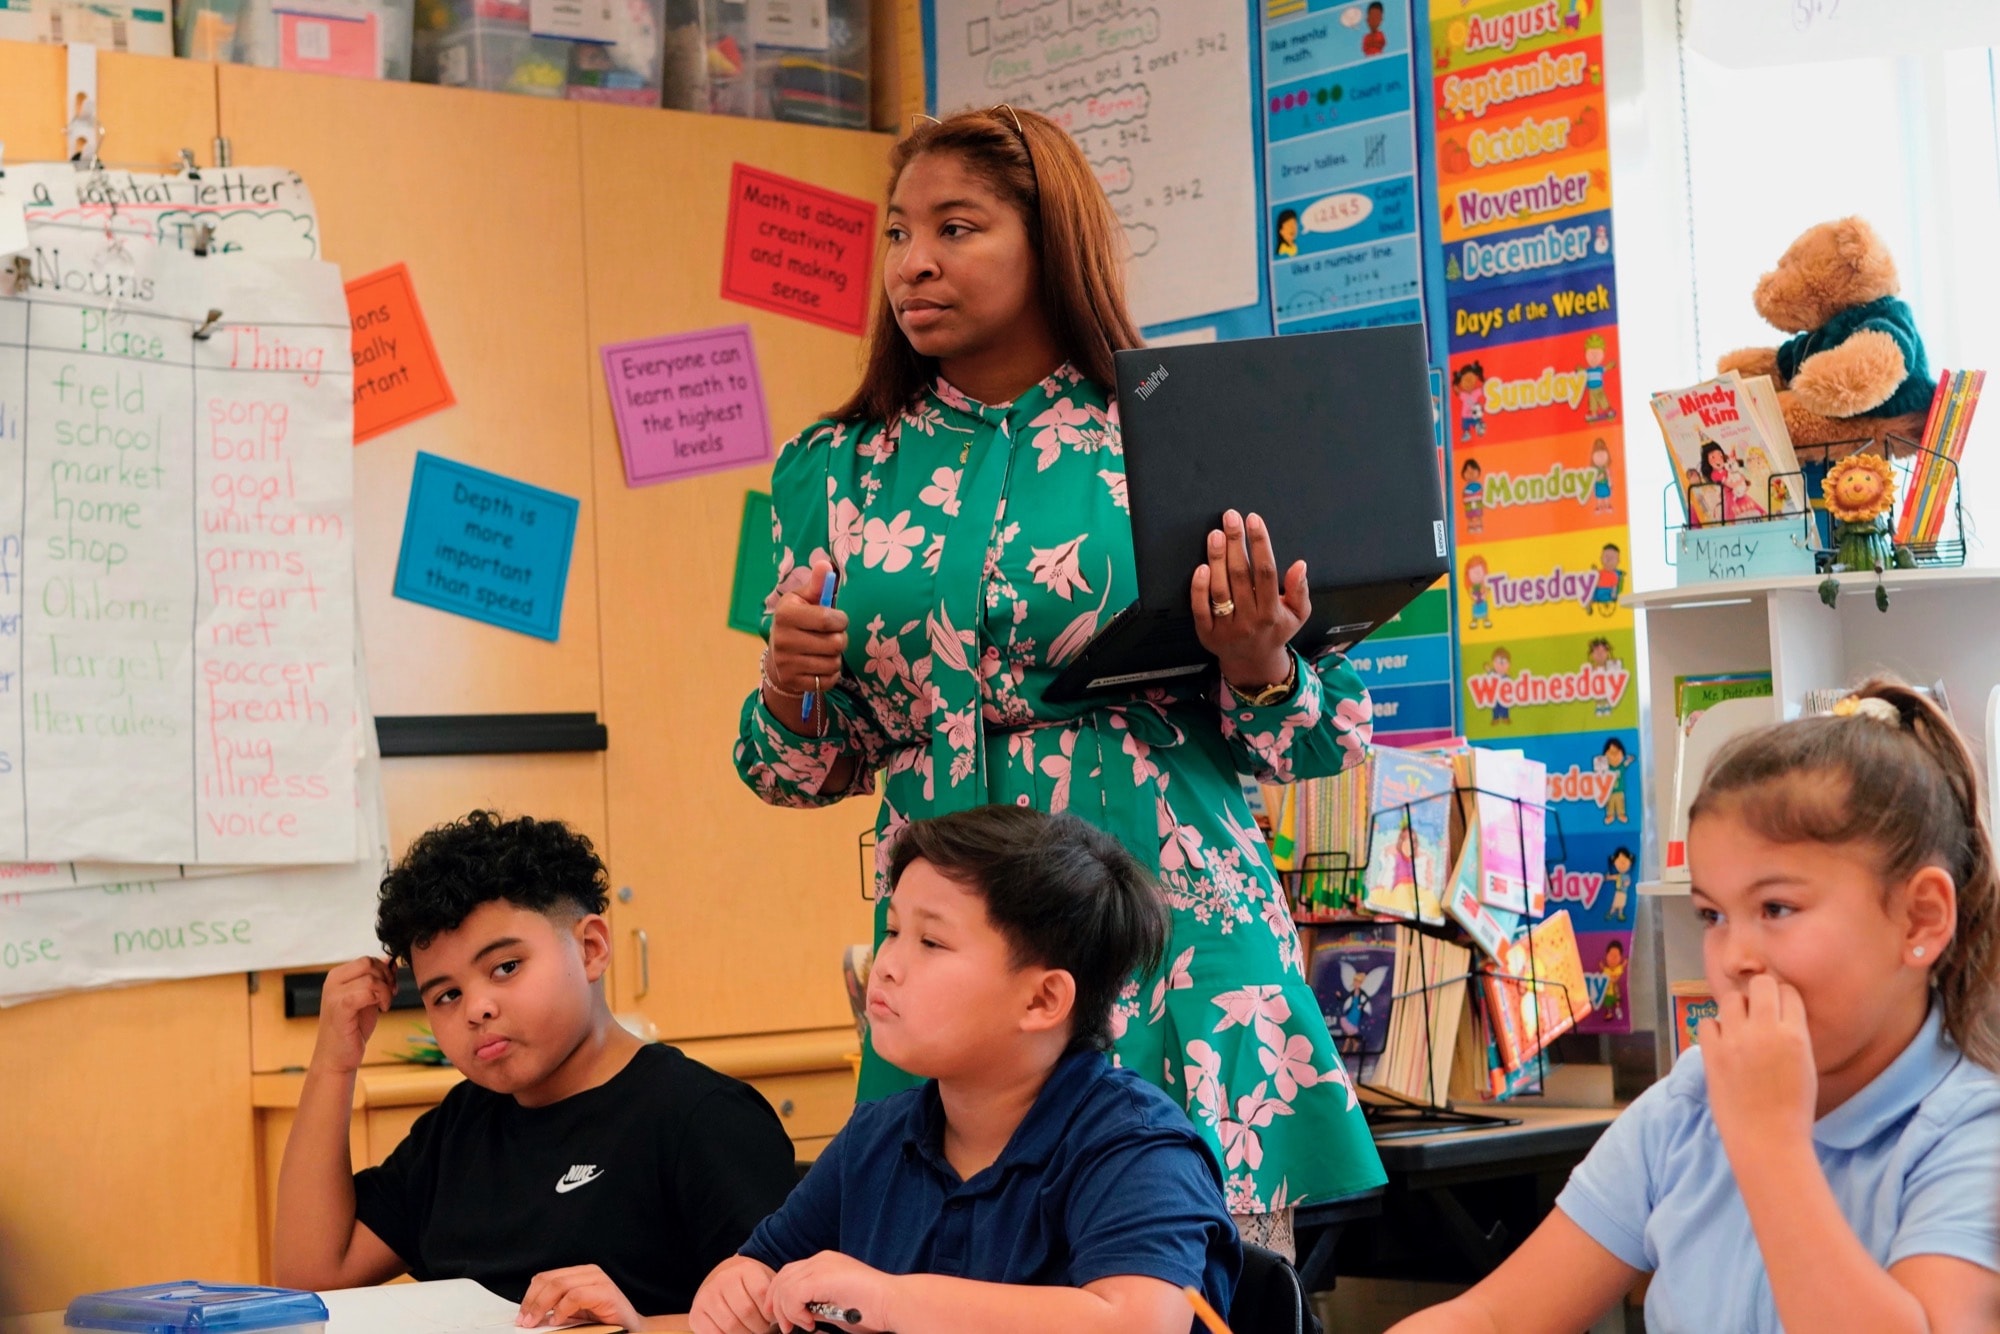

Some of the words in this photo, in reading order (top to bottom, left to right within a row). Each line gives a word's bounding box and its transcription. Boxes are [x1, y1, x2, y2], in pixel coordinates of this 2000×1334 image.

[1466, 1, 1559, 50] August
[1443, 52, 1586, 116] September
[1468, 117, 1569, 168] October
[744, 184, 791, 214] Math
[796, 199, 809, 219] is
[815, 207, 864, 236] about
[1458, 171, 1588, 228] November
[758, 219, 845, 261] creativity
[1463, 225, 1590, 280] December
[34, 248, 155, 300] Nouns
[751, 246, 782, 269] and
[788, 257, 848, 292] making
[772, 281, 821, 308] sense
[1455, 308, 1502, 337] Days
[1507, 303, 1521, 323] of
[1526, 302, 1548, 320] the
[1552, 284, 1611, 318] Week
[81, 308, 164, 361] Place
[223, 325, 324, 387] Thing
[621, 351, 705, 380] Everyone
[711, 347, 741, 366] can
[52, 364, 145, 415] field
[626, 387, 673, 409] learn
[679, 376, 724, 399] math
[729, 373, 747, 391] to
[1134, 364, 1170, 401] ThinkPad
[1484, 366, 1588, 414] Sunday
[1678, 385, 1735, 417] Mindy
[55, 412, 162, 449] school
[208, 398, 289, 437] song
[642, 412, 674, 434] the
[679, 402, 743, 432] highest
[1698, 407, 1740, 428] Kim
[211, 420, 283, 461] ball
[673, 433, 724, 459] levels
[52, 454, 166, 489] market
[211, 457, 295, 512] goal
[1483, 464, 1597, 507] Monday
[53, 490, 142, 530] home
[203, 497, 343, 540] uniform
[453, 482, 513, 517] Depth
[519, 506, 537, 526] is
[48, 522, 128, 575] shop
[464, 521, 514, 550] more
[1696, 538, 1759, 562] Mindy
[206, 547, 304, 575] arms
[435, 538, 533, 584] important
[1709, 558, 1746, 579] Kim
[212, 570, 326, 612] heart
[426, 569, 471, 598] than
[476, 586, 534, 617] speed
[1487, 567, 1599, 607] Tuesday
[212, 612, 278, 646] net
[204, 659, 328, 686] soccer
[1376, 655, 1408, 674] year
[1468, 661, 1630, 709] Wednesday
[33, 691, 177, 737] Hercules
[210, 684, 328, 726] breath
[204, 760, 330, 799] illness
[1546, 766, 1615, 807] sday
[208, 808, 298, 836] voice
[114, 918, 252, 956] mousse
[564, 1164, 597, 1182] NIKE
